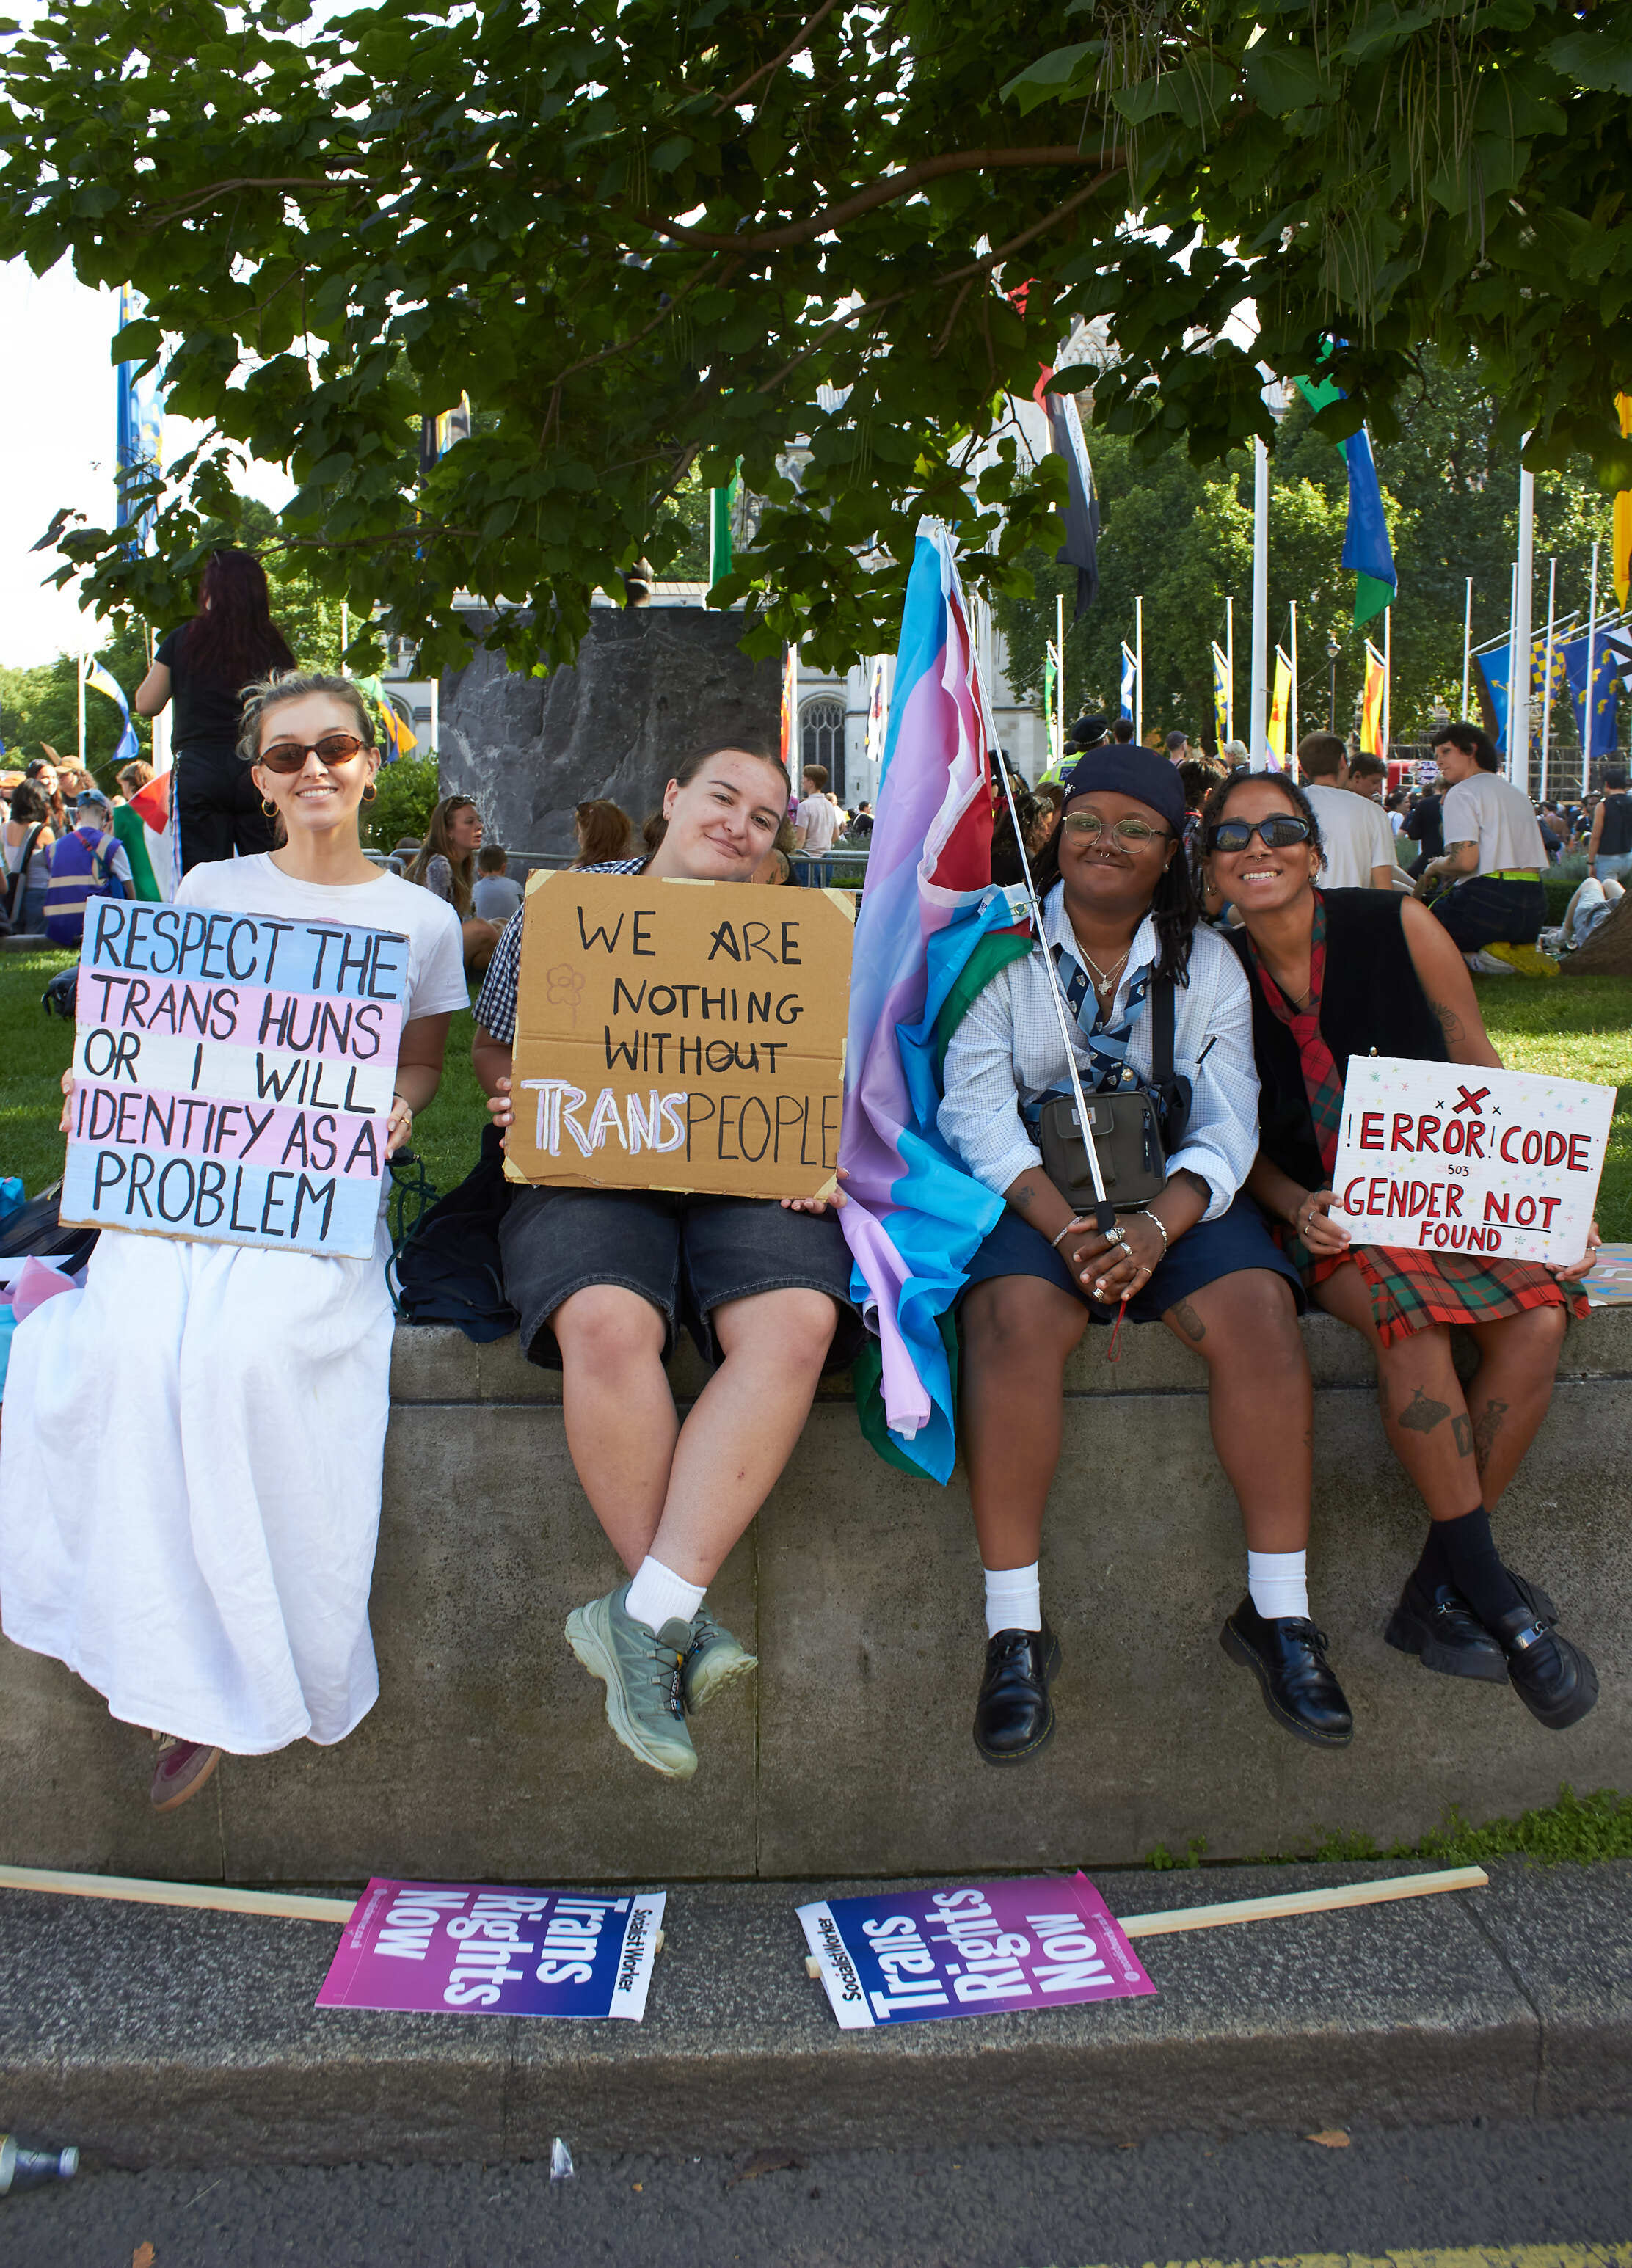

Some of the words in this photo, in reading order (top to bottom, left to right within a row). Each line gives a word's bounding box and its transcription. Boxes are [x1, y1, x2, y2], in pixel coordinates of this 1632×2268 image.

[94, 904, 294, 983] RESPECT
[307, 928, 407, 999] THE
[577, 905, 656, 956] WE
[707, 920, 801, 965] ARE
[91, 974, 239, 1040] TRANS
[258, 992, 383, 1060] HUNS
[613, 977, 804, 1024] NOTHING
[84, 1028, 141, 1083] OR
[191, 1043, 203, 1091] I
[256, 1051, 376, 1114] WILL
[604, 1025, 788, 1076] WITHOUT
[77, 1087, 275, 1159] IDENTIFY
[281, 1111, 337, 1171] AS
[343, 1120, 379, 1177] A
[1447, 1164, 1469, 1177] 503
[1499, 1126, 1592, 1172] CODE
[92, 1150, 336, 1241] PROBLEM
[1344, 1176, 1464, 1218] GENDER
[1483, 1190, 1562, 1229] NOT
[1418, 1220, 1502, 1252] FOUND
[373, 1889, 470, 1961] Now
[442, 1892, 550, 2006] Rights
[536, 1897, 631, 1985] Trans
[861, 1914, 950, 2019] Trans
[925, 1888, 1034, 2003] Rights
[1025, 1913, 1115, 1994] Now
